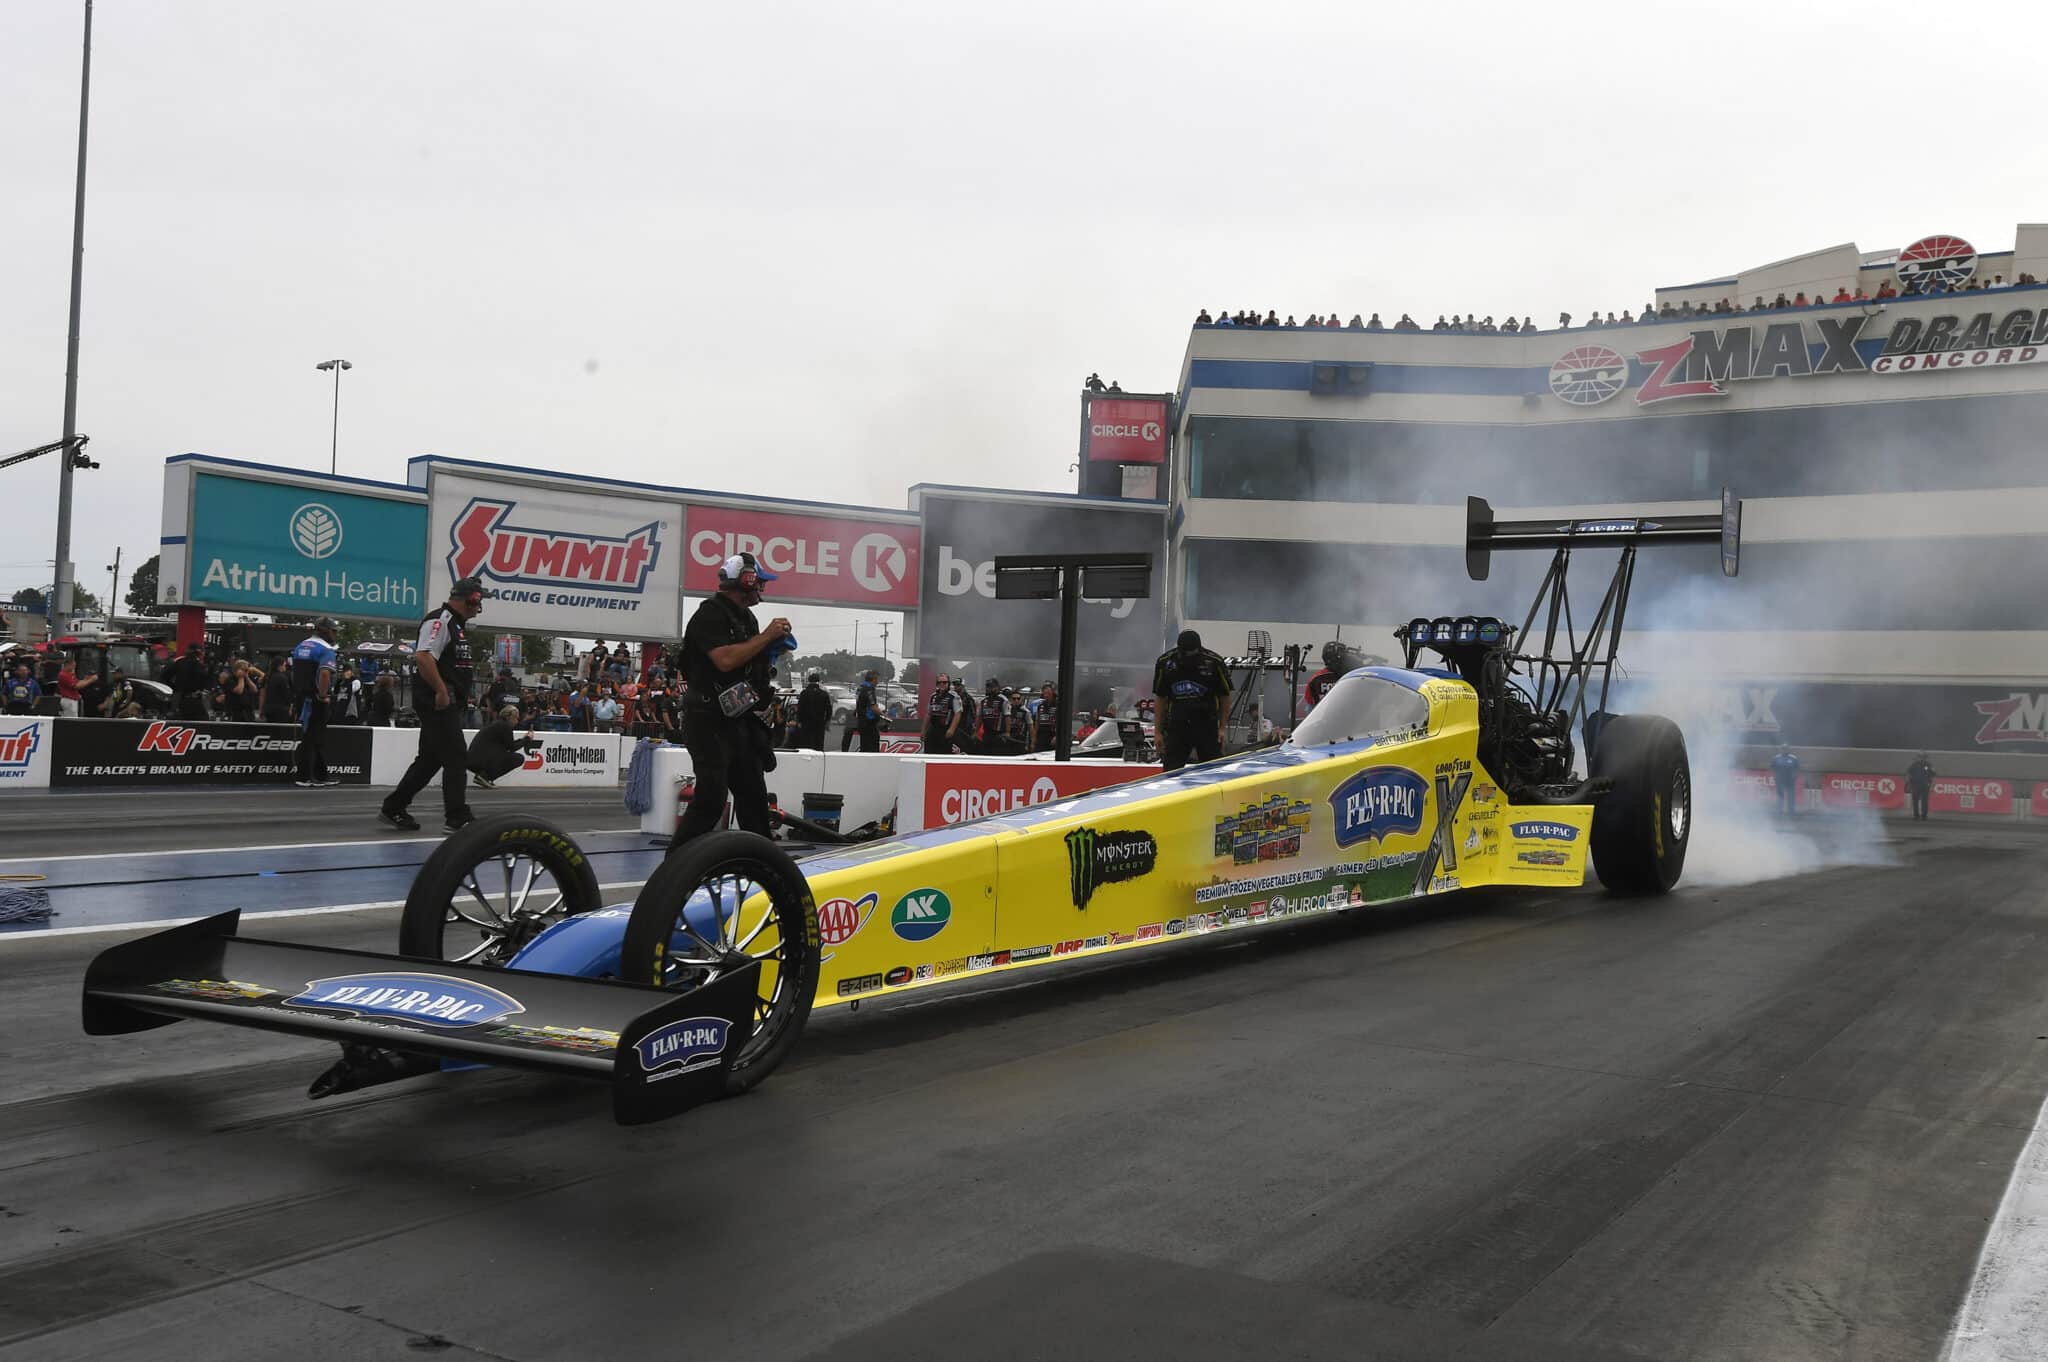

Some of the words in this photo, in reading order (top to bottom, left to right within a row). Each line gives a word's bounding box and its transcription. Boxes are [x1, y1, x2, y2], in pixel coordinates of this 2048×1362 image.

[1876, 348, 2037, 372] CONCORD
[1092, 425, 1138, 437] CIRCLE
[1144, 424, 1160, 440] K
[690, 530, 840, 576] CIRCLE
[857, 539, 906, 589] K
[203, 558, 318, 597] Atrium
[324, 570, 417, 606] Health
[483, 587, 541, 604] ACING
[546, 593, 641, 611] EQUIPMENT
[189, 735, 302, 751] RaceGear
[65, 766, 90, 775] THE
[93, 766, 146, 775] RACER'S
[150, 765, 192, 774] BRAND
[195, 765, 210, 774] OF
[213, 765, 255, 774] SAFETY
[258, 765, 287, 774] GEAR
[326, 765, 361, 774] PAREL
[1436, 759, 1471, 774] GOODYEAR
[1831, 779, 1875, 790] CIRCLE
[1879, 779, 1895, 794] K
[1934, 783, 1980, 795] CIRCLE
[1985, 784, 2002, 798] K
[941, 788, 1025, 823] CIRCLE
[1097, 840, 1152, 862] MONSTER
[1105, 861, 1144, 872] ENERGY
[1197, 885, 1229, 901] PREMIUM
[1230, 880, 1257, 895] FROZEN
[1258, 873, 1297, 889] VEGETABLES
[1303, 869, 1323, 881] FRUITS
[1228, 907, 1248, 919] WELD
[818, 899, 858, 944] AAA
[1137, 924, 1162, 940] SIMPSON
[1054, 939, 1084, 954] ARP
[1086, 936, 1107, 949] MAHLE
